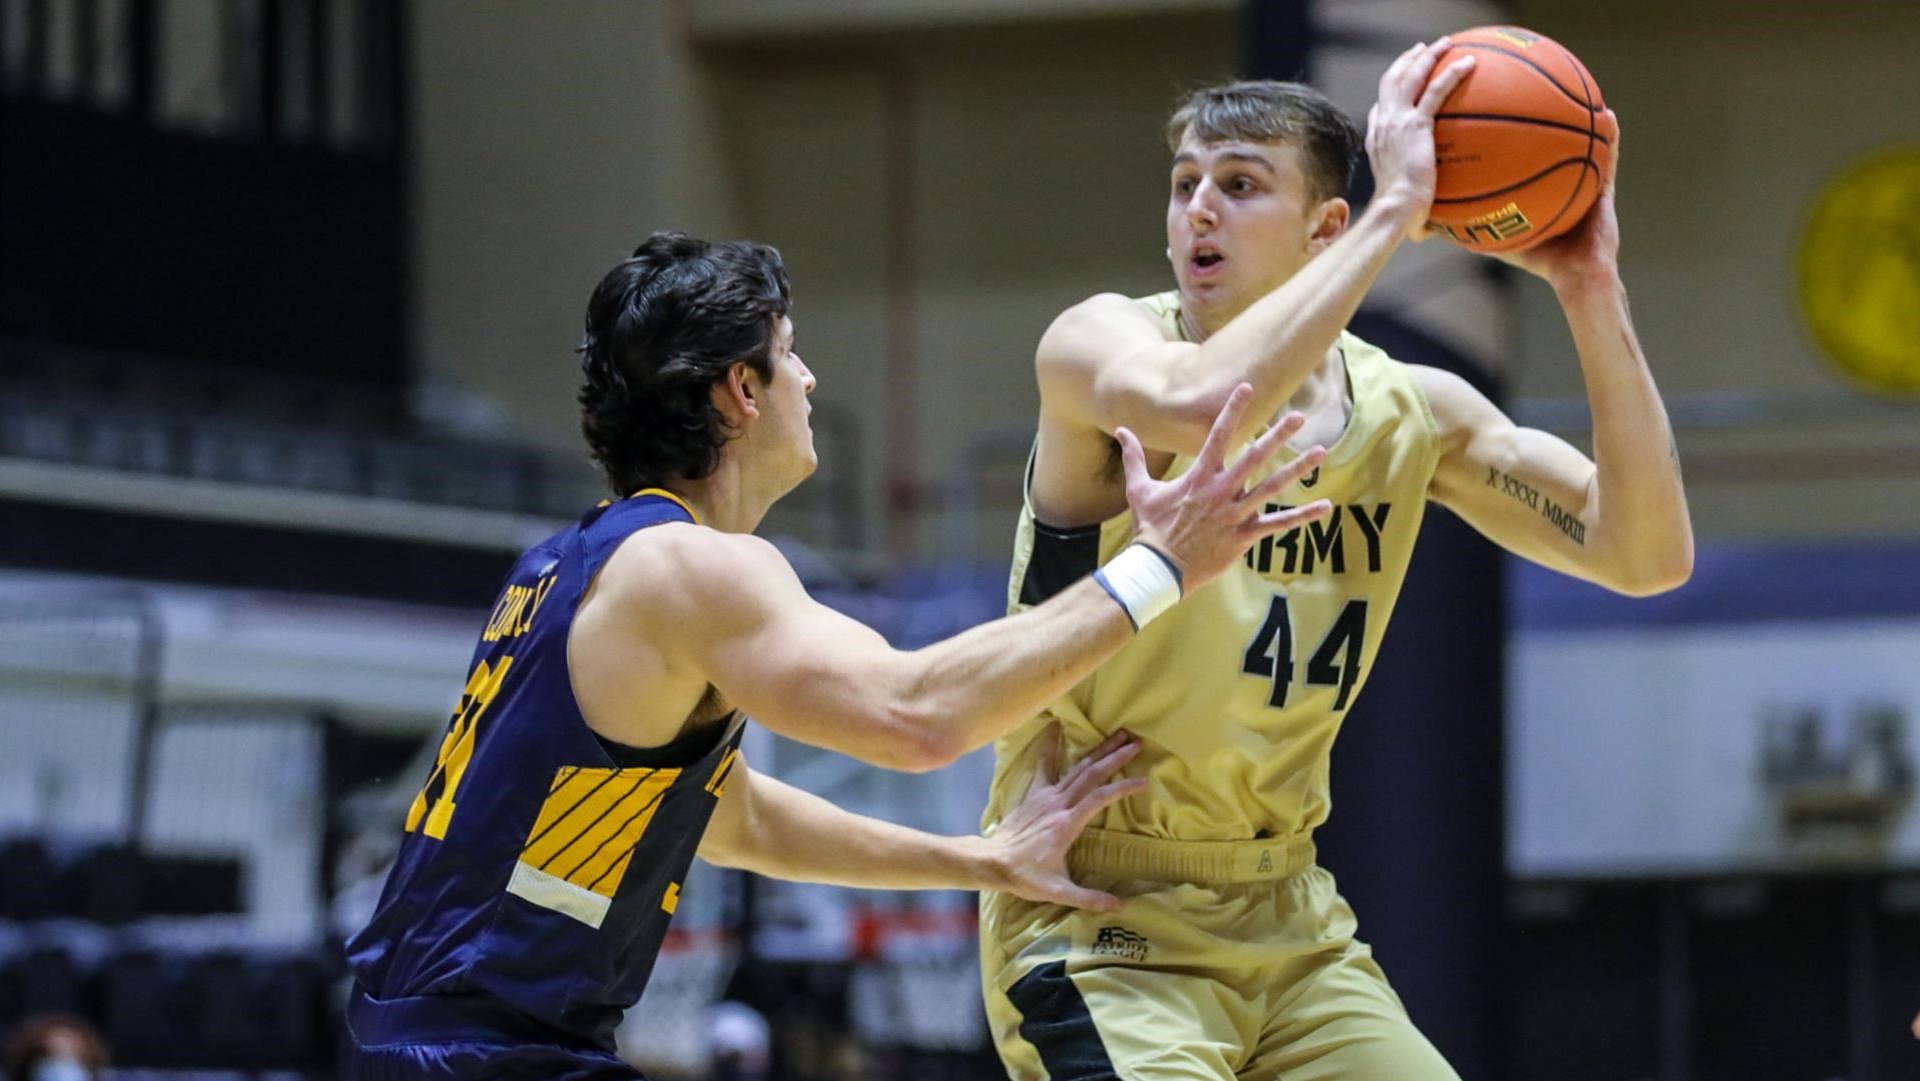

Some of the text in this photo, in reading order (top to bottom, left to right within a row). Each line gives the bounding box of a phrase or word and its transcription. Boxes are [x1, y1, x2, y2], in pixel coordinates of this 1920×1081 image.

[1502, 473, 1539, 510] XXXI
[1244, 502, 1391, 574] RMY
[1242, 594, 1369, 712] 44
